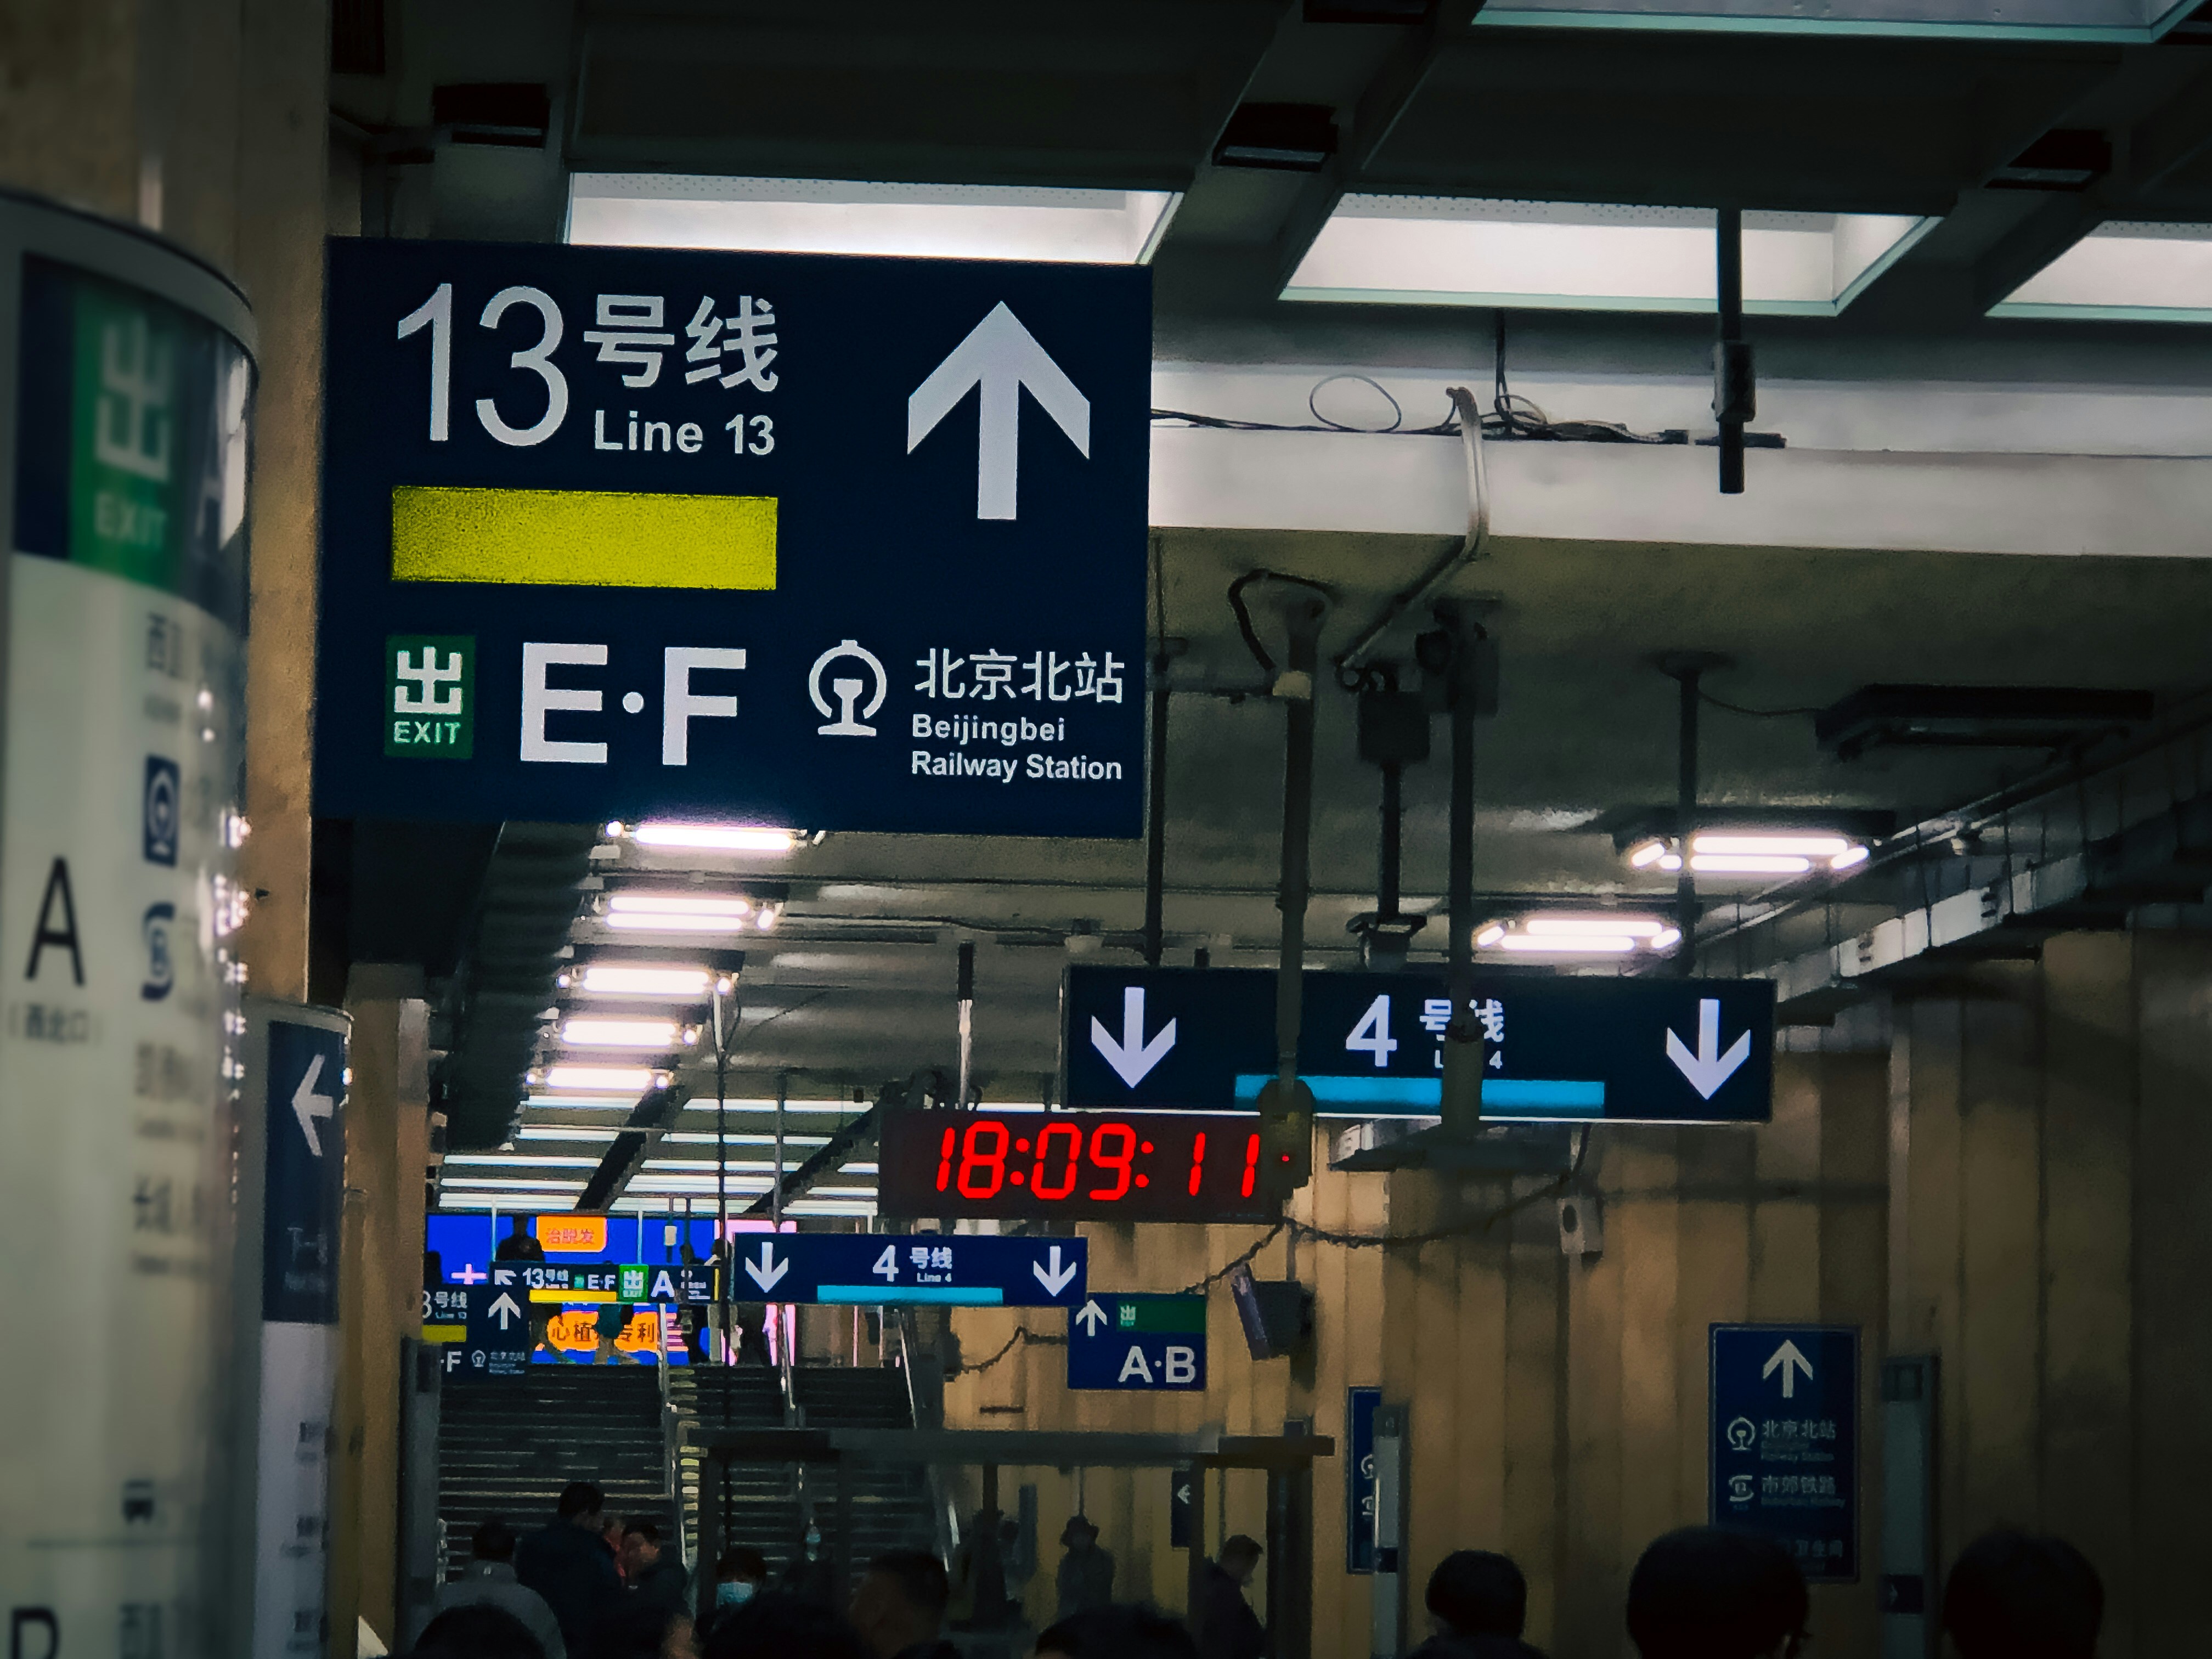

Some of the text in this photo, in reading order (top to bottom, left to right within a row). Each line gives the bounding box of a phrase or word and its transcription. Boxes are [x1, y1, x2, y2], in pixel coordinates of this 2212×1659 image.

[595, 410, 775, 455] Line 13
[394, 646, 462, 715] 出
[915, 648, 1125, 704] 北京北站
[394, 721, 460, 744] EXIT
[912, 714, 1065, 746] Beijingbei
[911, 750, 1122, 782] Railway Station
[26, 855, 85, 986] A
[936, 1120, 1260, 1201] 18:09:11
[909, 1246, 953, 1269] 号线
[650, 1270, 675, 1300] A
[1761, 1419, 1836, 1440] 北京北站
